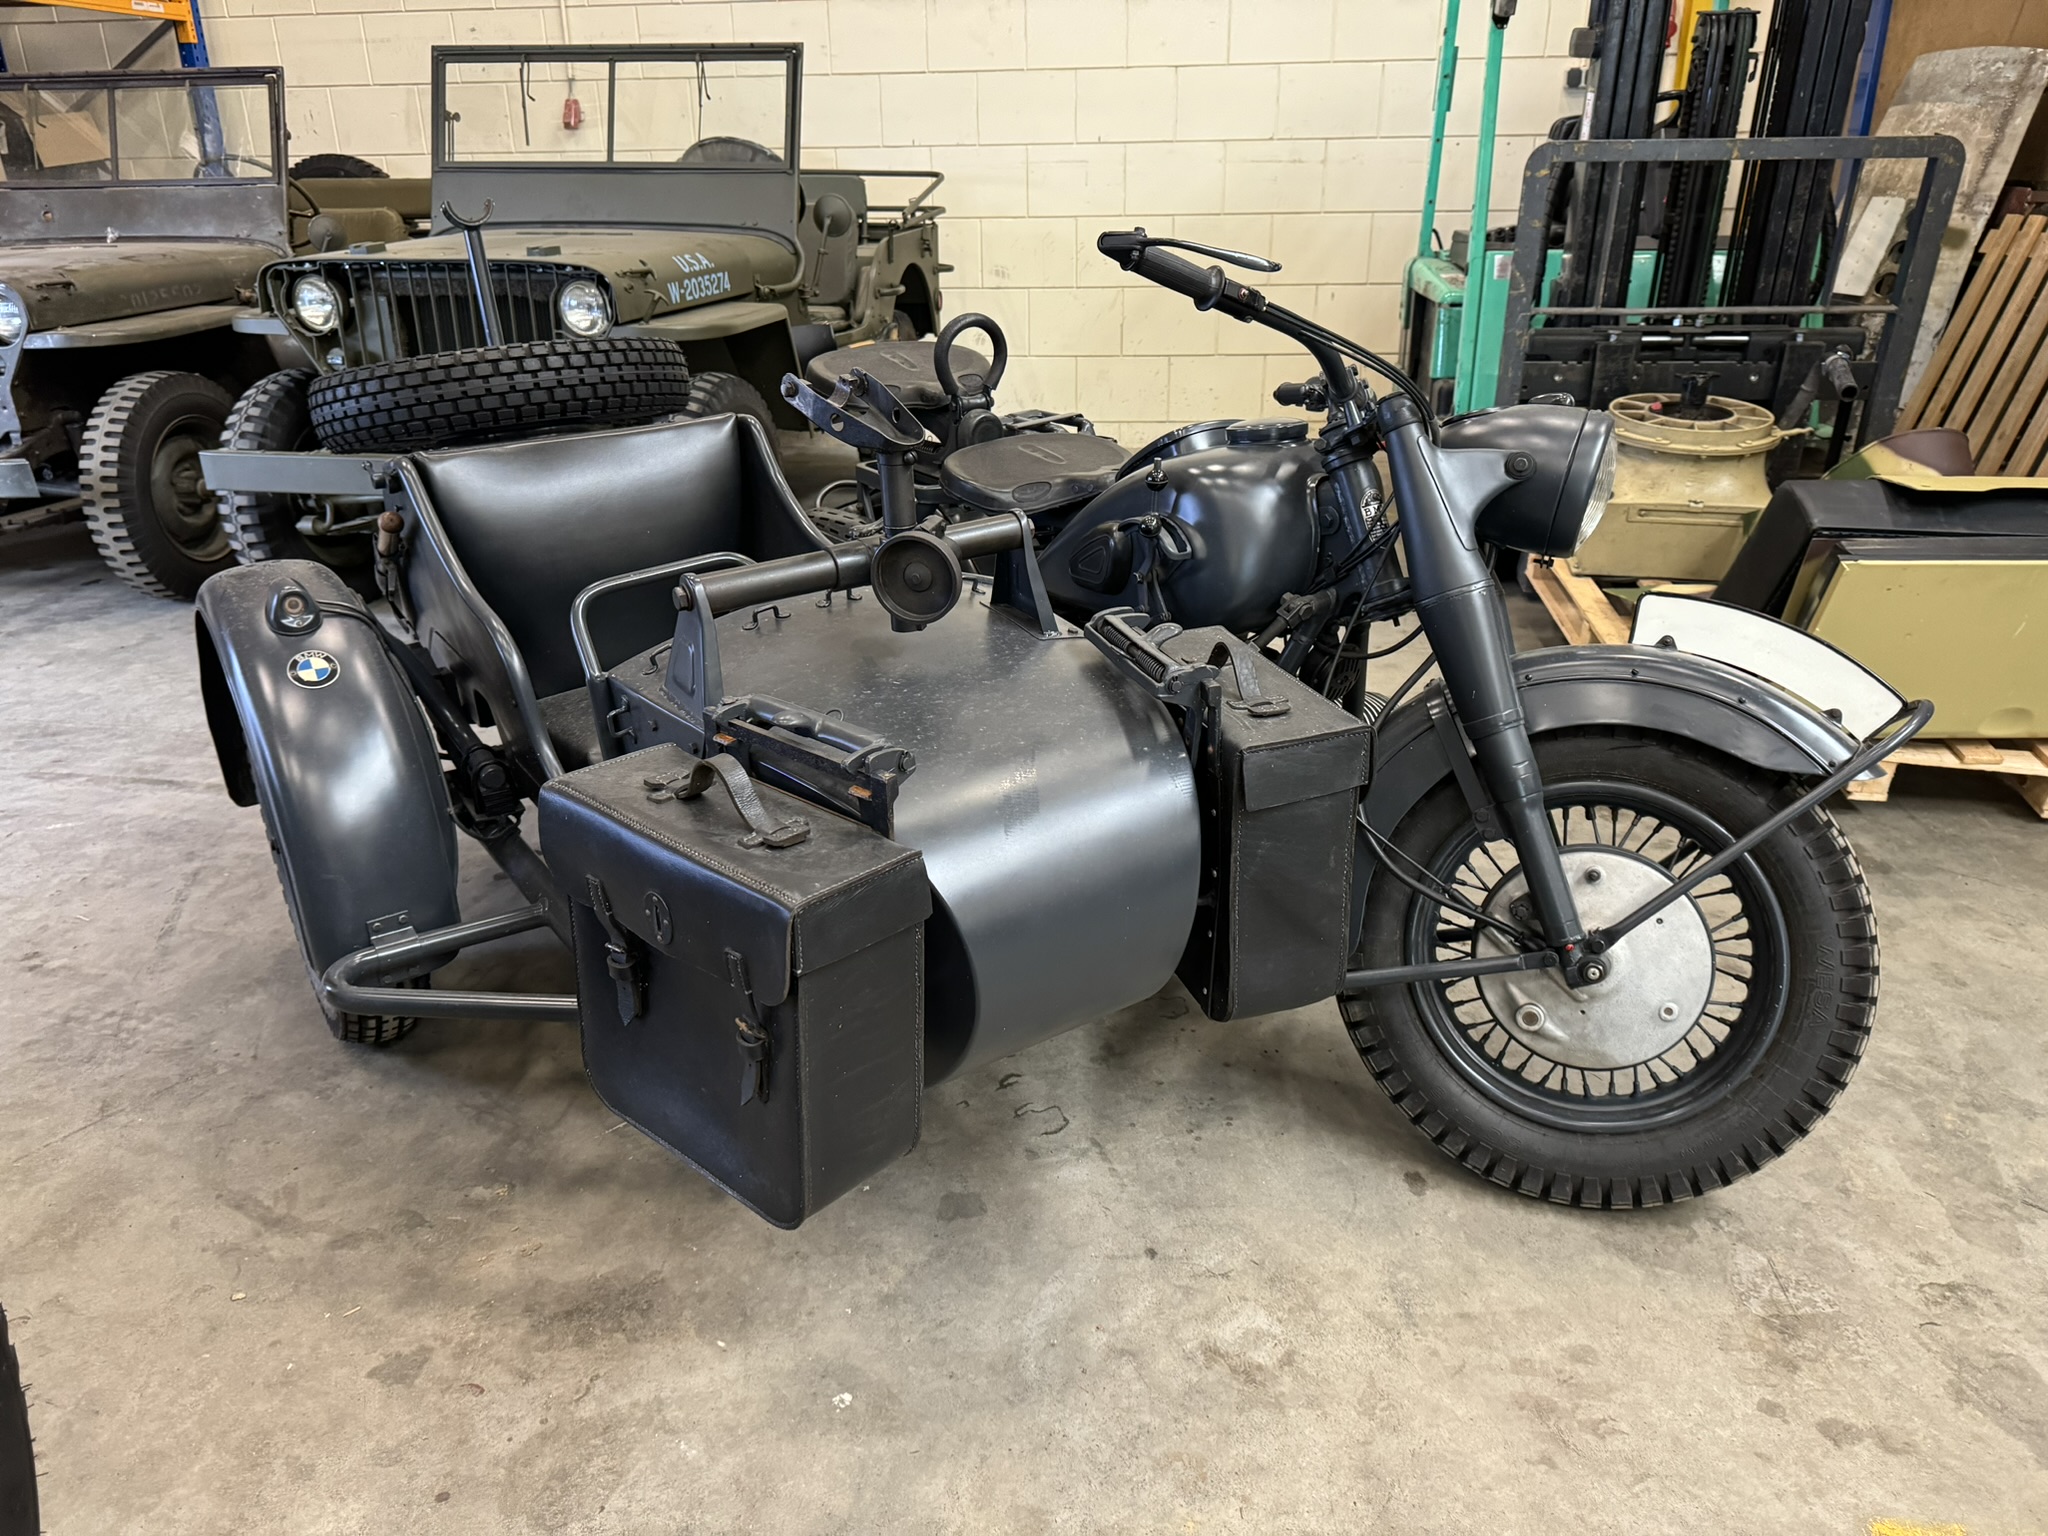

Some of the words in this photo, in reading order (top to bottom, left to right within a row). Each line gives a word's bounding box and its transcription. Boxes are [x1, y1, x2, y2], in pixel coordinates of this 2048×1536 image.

[672, 252, 716, 274] U.S.A.
[667, 271, 731, 305] W-2035274
[294, 651, 328, 662] BMW
